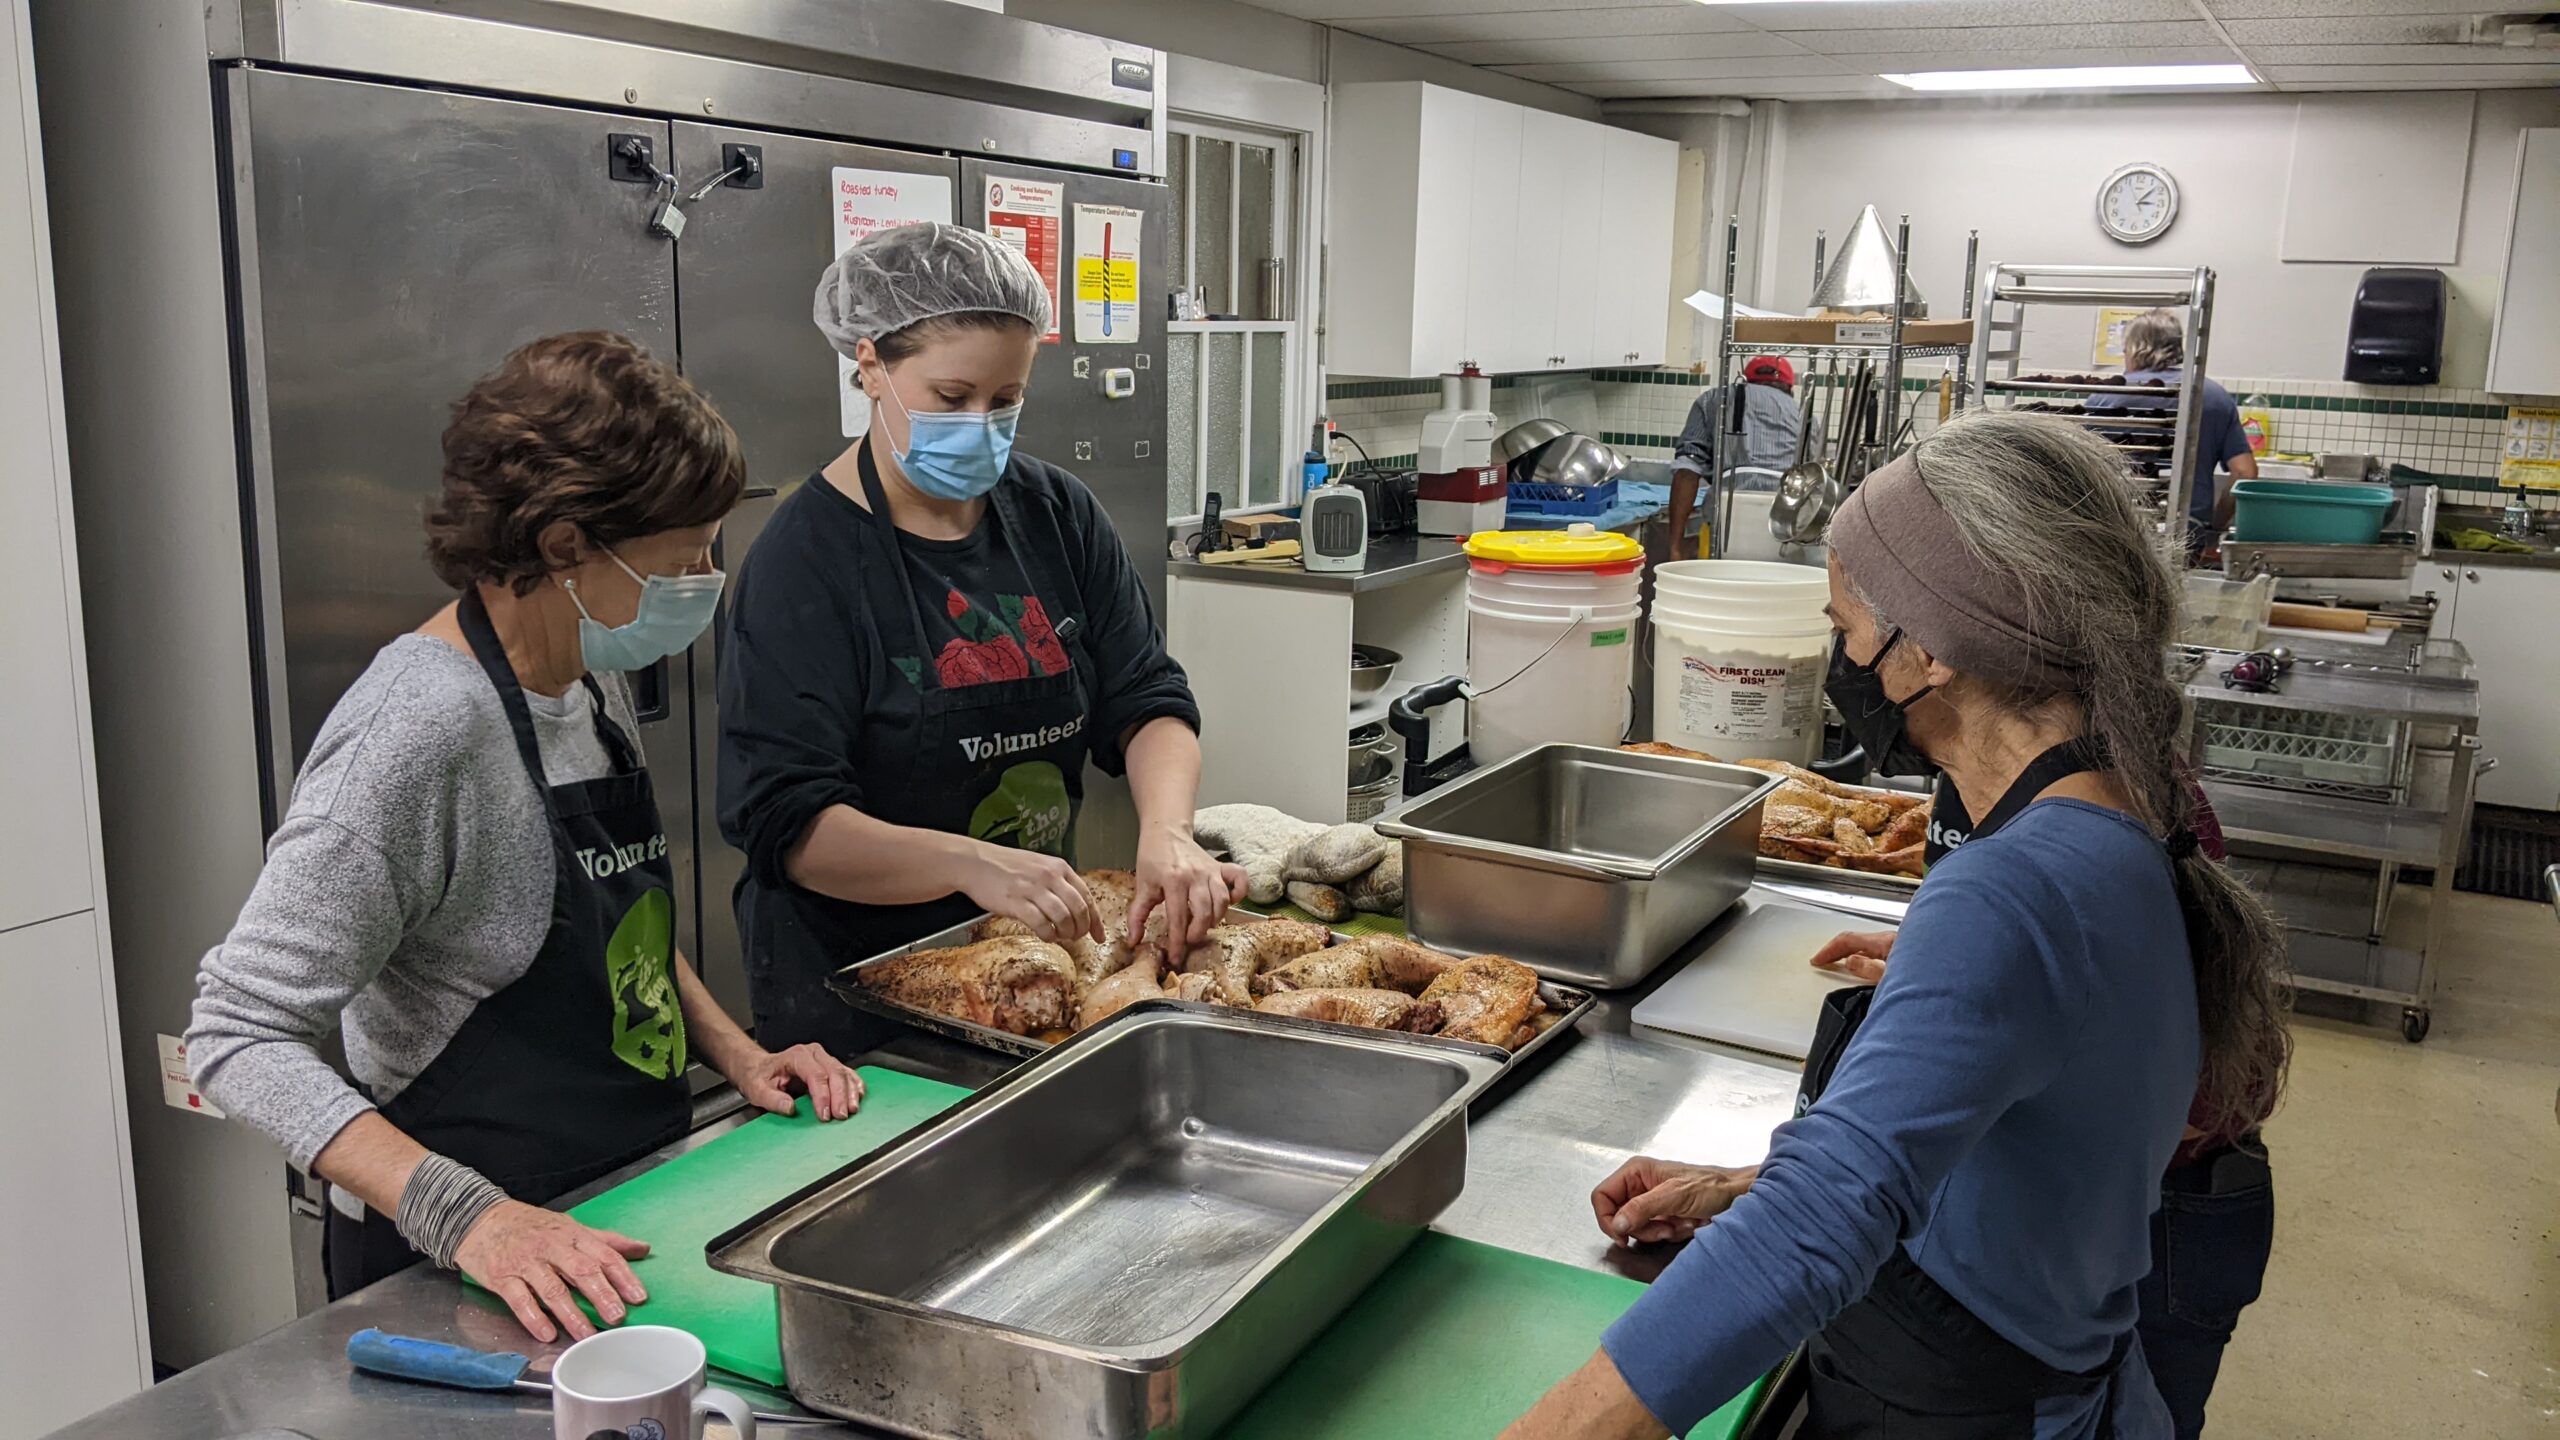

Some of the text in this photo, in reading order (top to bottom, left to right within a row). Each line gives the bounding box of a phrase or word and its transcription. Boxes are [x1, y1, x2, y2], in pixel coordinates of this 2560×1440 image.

[841, 181, 898, 202] Roasted turkey
[843, 200, 852, 212] OR
[1719, 667, 1785, 676] FIRST CLEAN
[1740, 677, 1765, 685] DISH
[959, 714, 1085, 762] Volunteer
[1025, 806, 1060, 837] the
